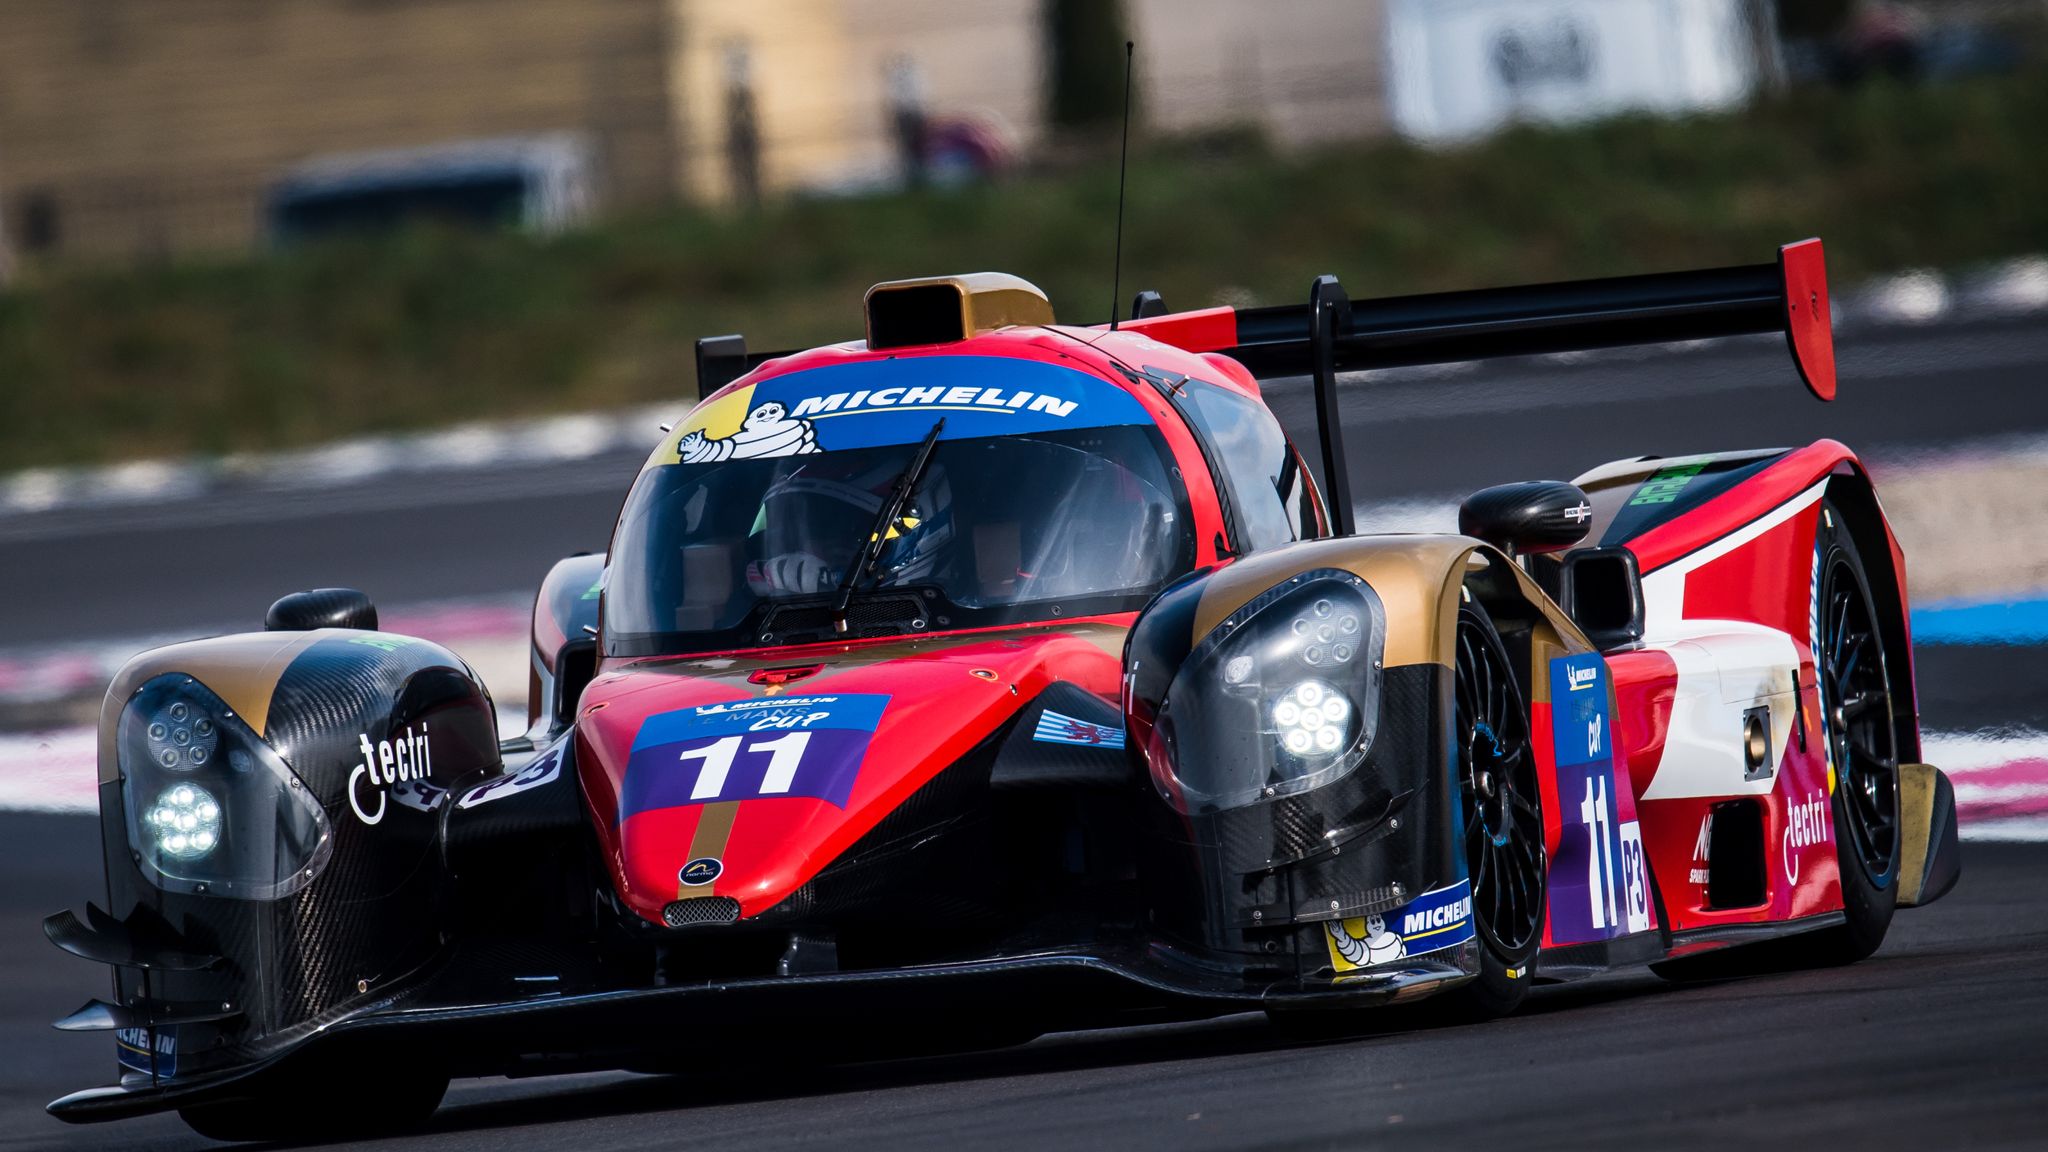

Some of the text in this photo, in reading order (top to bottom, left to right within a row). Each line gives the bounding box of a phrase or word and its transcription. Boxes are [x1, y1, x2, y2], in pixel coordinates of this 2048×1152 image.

[790, 386, 1079, 418] MICHELIN
[725, 706, 812, 722] MANS
[731, 697, 838, 710] MICHELIN
[749, 712, 830, 731] CUP
[358, 721, 432, 788] tectri
[469, 749, 559, 802] P3
[679, 731, 812, 800] 11
[1581, 775, 1618, 929] 11
[1692, 813, 1713, 861] NG
[1622, 838, 1646, 916] P3
[1404, 895, 1471, 935] MICHELIN
